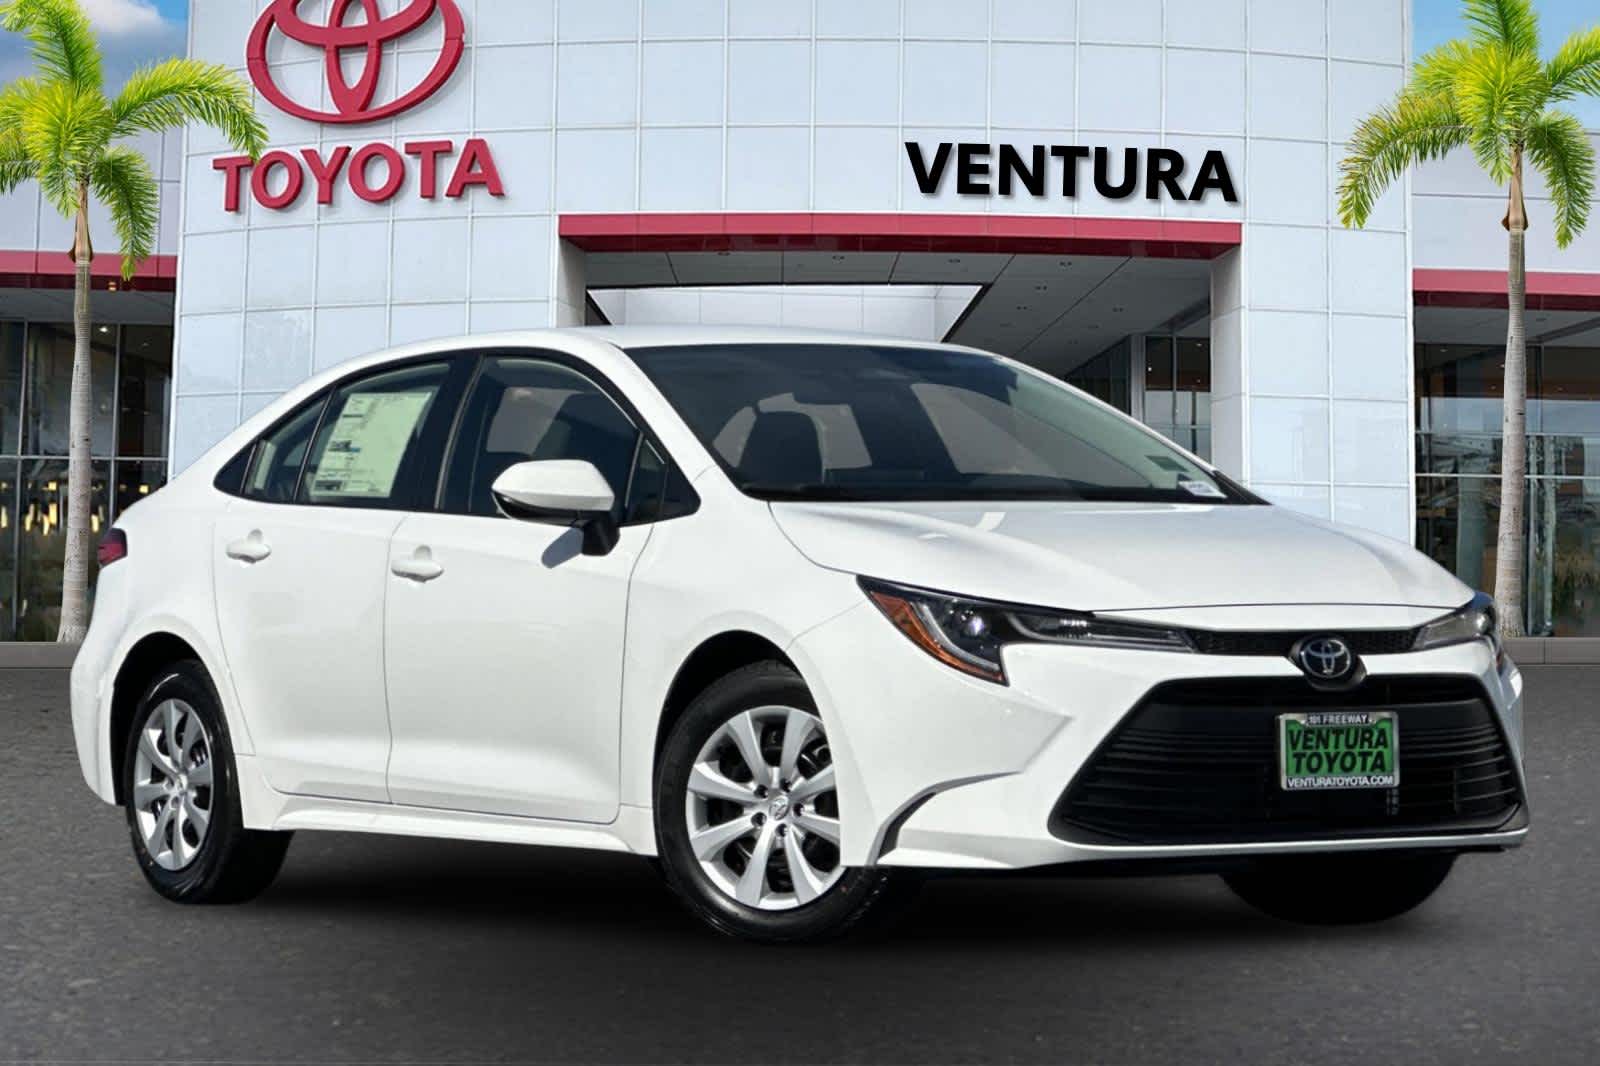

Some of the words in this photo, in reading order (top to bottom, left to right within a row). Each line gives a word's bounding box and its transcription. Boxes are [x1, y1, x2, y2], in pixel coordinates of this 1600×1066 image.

[212, 139, 505, 212] TOYOTA
[904, 142, 1238, 202] VENTURA
[1323, 714, 1368, 724] FREEWAY
[1288, 727, 1388, 750] VENTURA
[1293, 751, 1386, 773] TOYOTA
[1287, 776, 1393, 788] VENTURATOYOTA.COM
